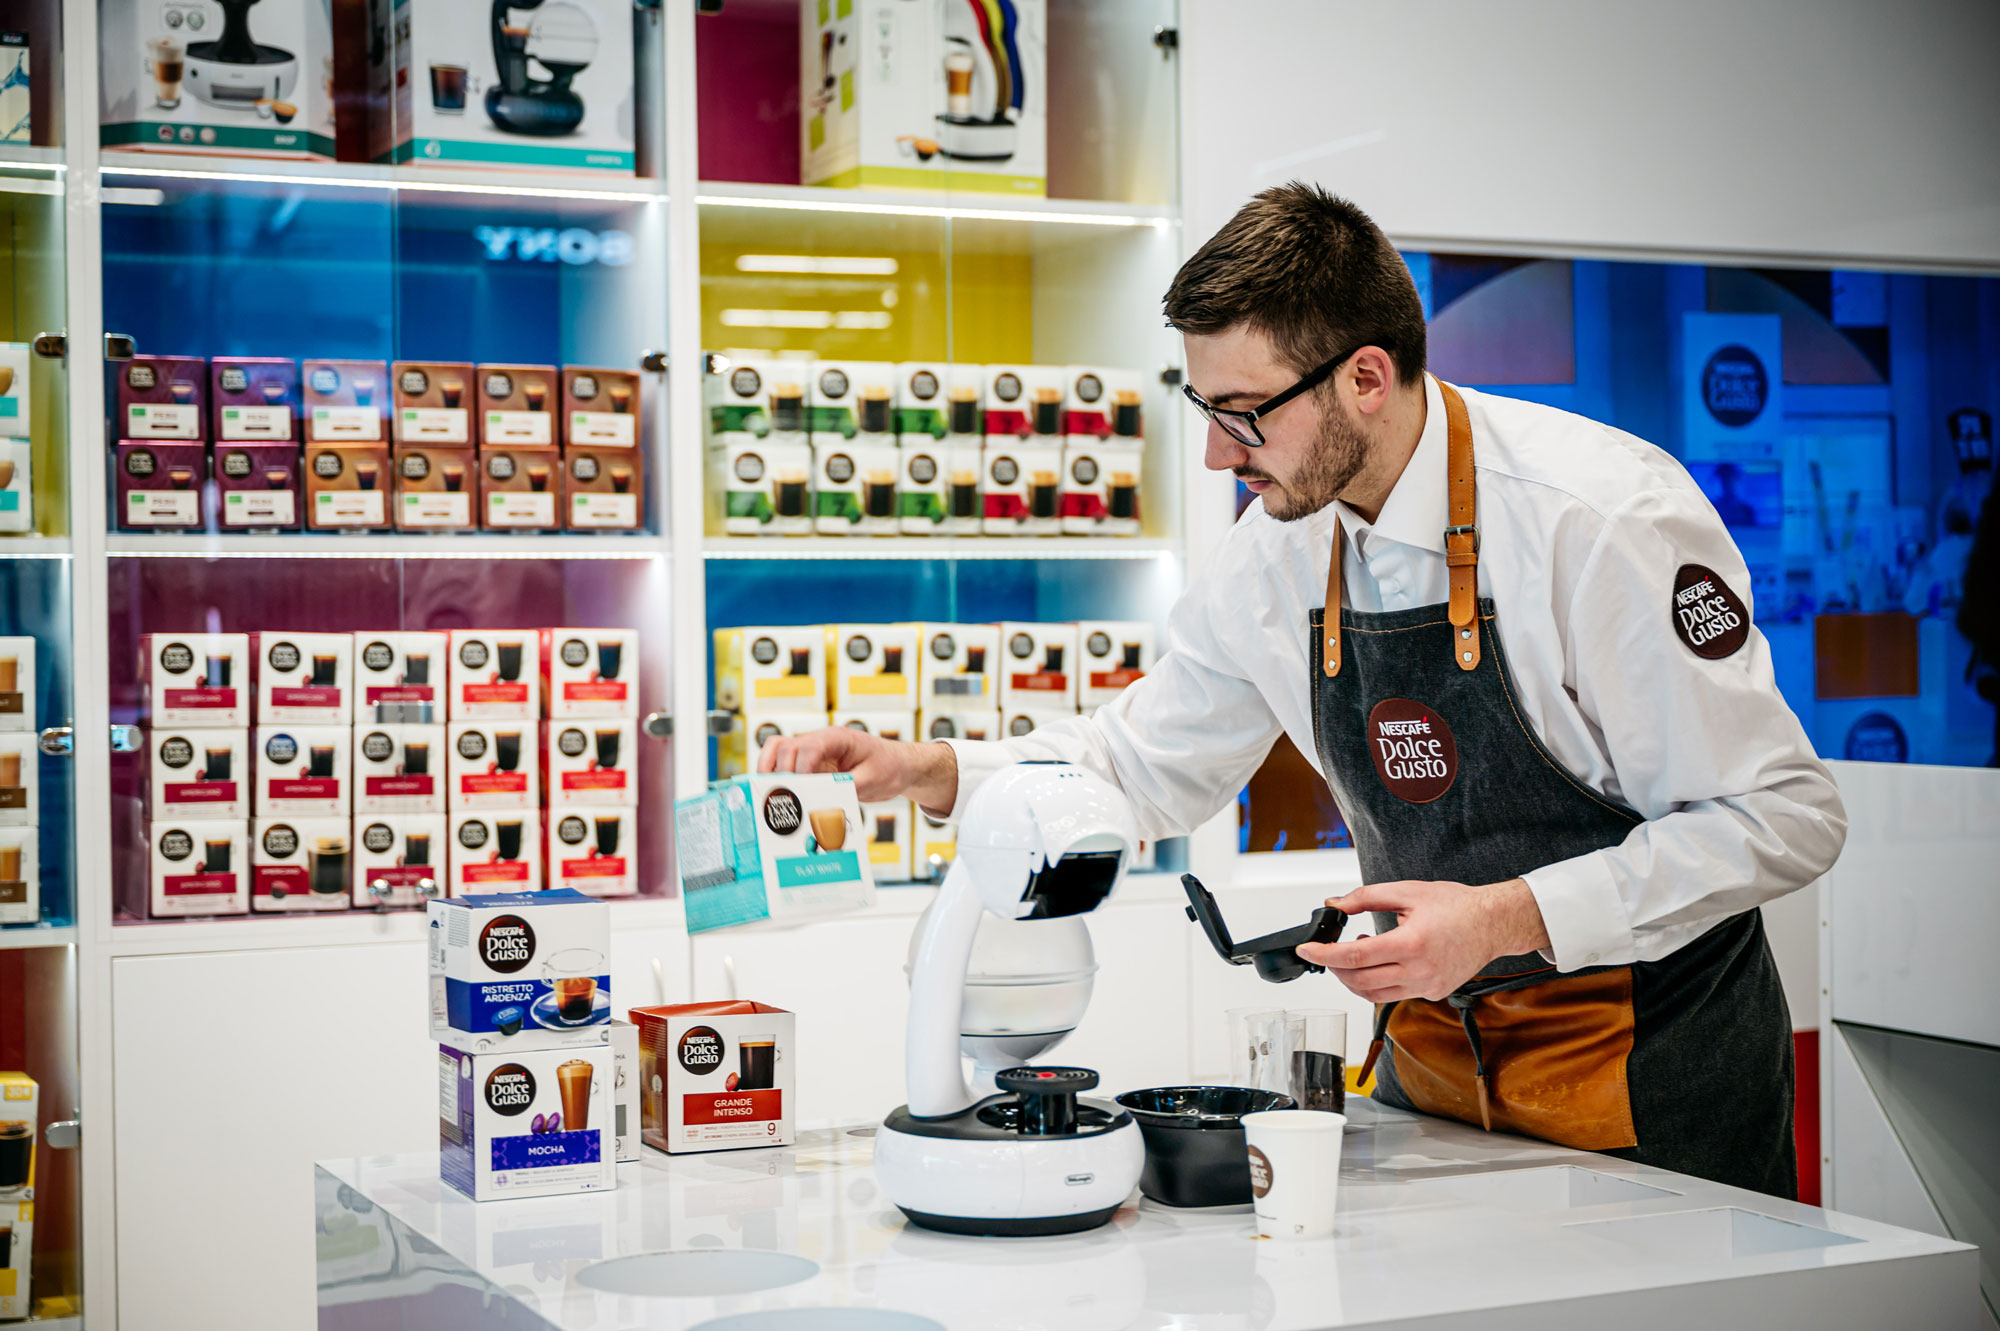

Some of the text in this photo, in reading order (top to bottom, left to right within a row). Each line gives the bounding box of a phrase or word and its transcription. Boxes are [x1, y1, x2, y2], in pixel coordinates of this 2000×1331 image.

[1678, 595, 1730, 630] Dolce
[1688, 612, 1740, 646] Gusto
[1376, 736, 1443, 760] Dolce
[1384, 757, 1447, 779] Gusto
[486, 937, 529, 951] Dolce
[487, 949, 529, 962] Gusto
[482, 984, 534, 995] RISTRETTO
[684, 1044, 719, 1056] Dolce
[684, 1054, 719, 1065] Gusto
[491, 1083, 530, 1097] Dolce
[492, 1094, 530, 1106] Gusto
[714, 1098, 753, 1108] GRANDE
[713, 1107, 753, 1117] INTENSO
[767, 1122, 776, 1136] 9
[528, 1145, 566, 1156] MOCHA
